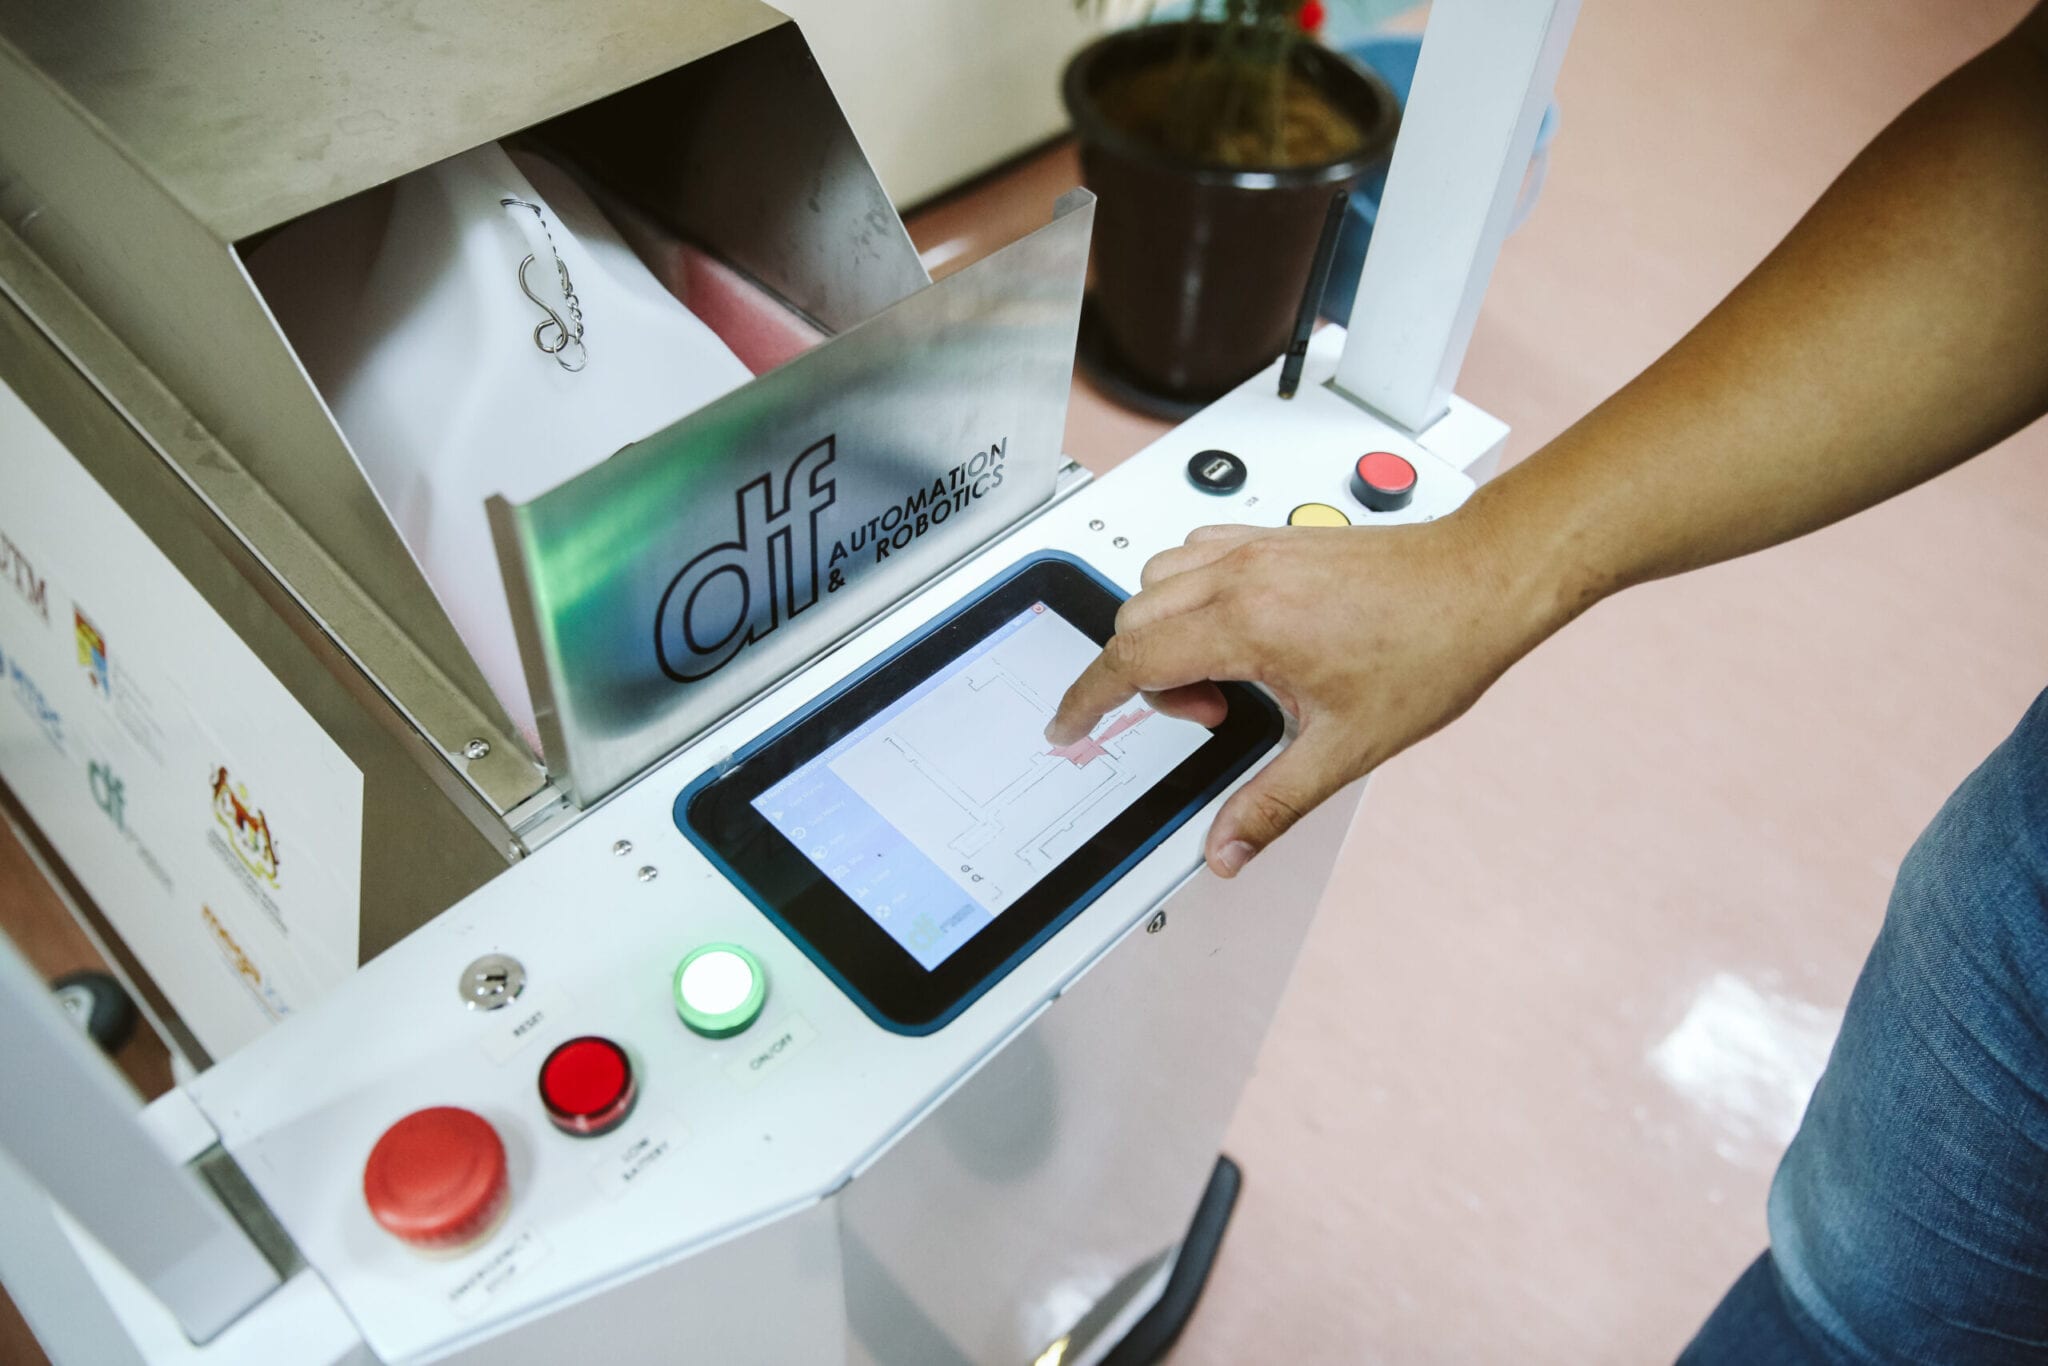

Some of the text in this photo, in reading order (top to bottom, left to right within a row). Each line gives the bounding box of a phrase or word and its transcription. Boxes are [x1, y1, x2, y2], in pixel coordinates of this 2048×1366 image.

[654, 433, 836, 683] df
[827, 464, 1005, 594] & ROBOTICS
[828, 436, 1008, 569] AUTOMATION
[513, 1010, 545, 1038] RESET
[749, 1033, 794, 1071] ON/OFF
